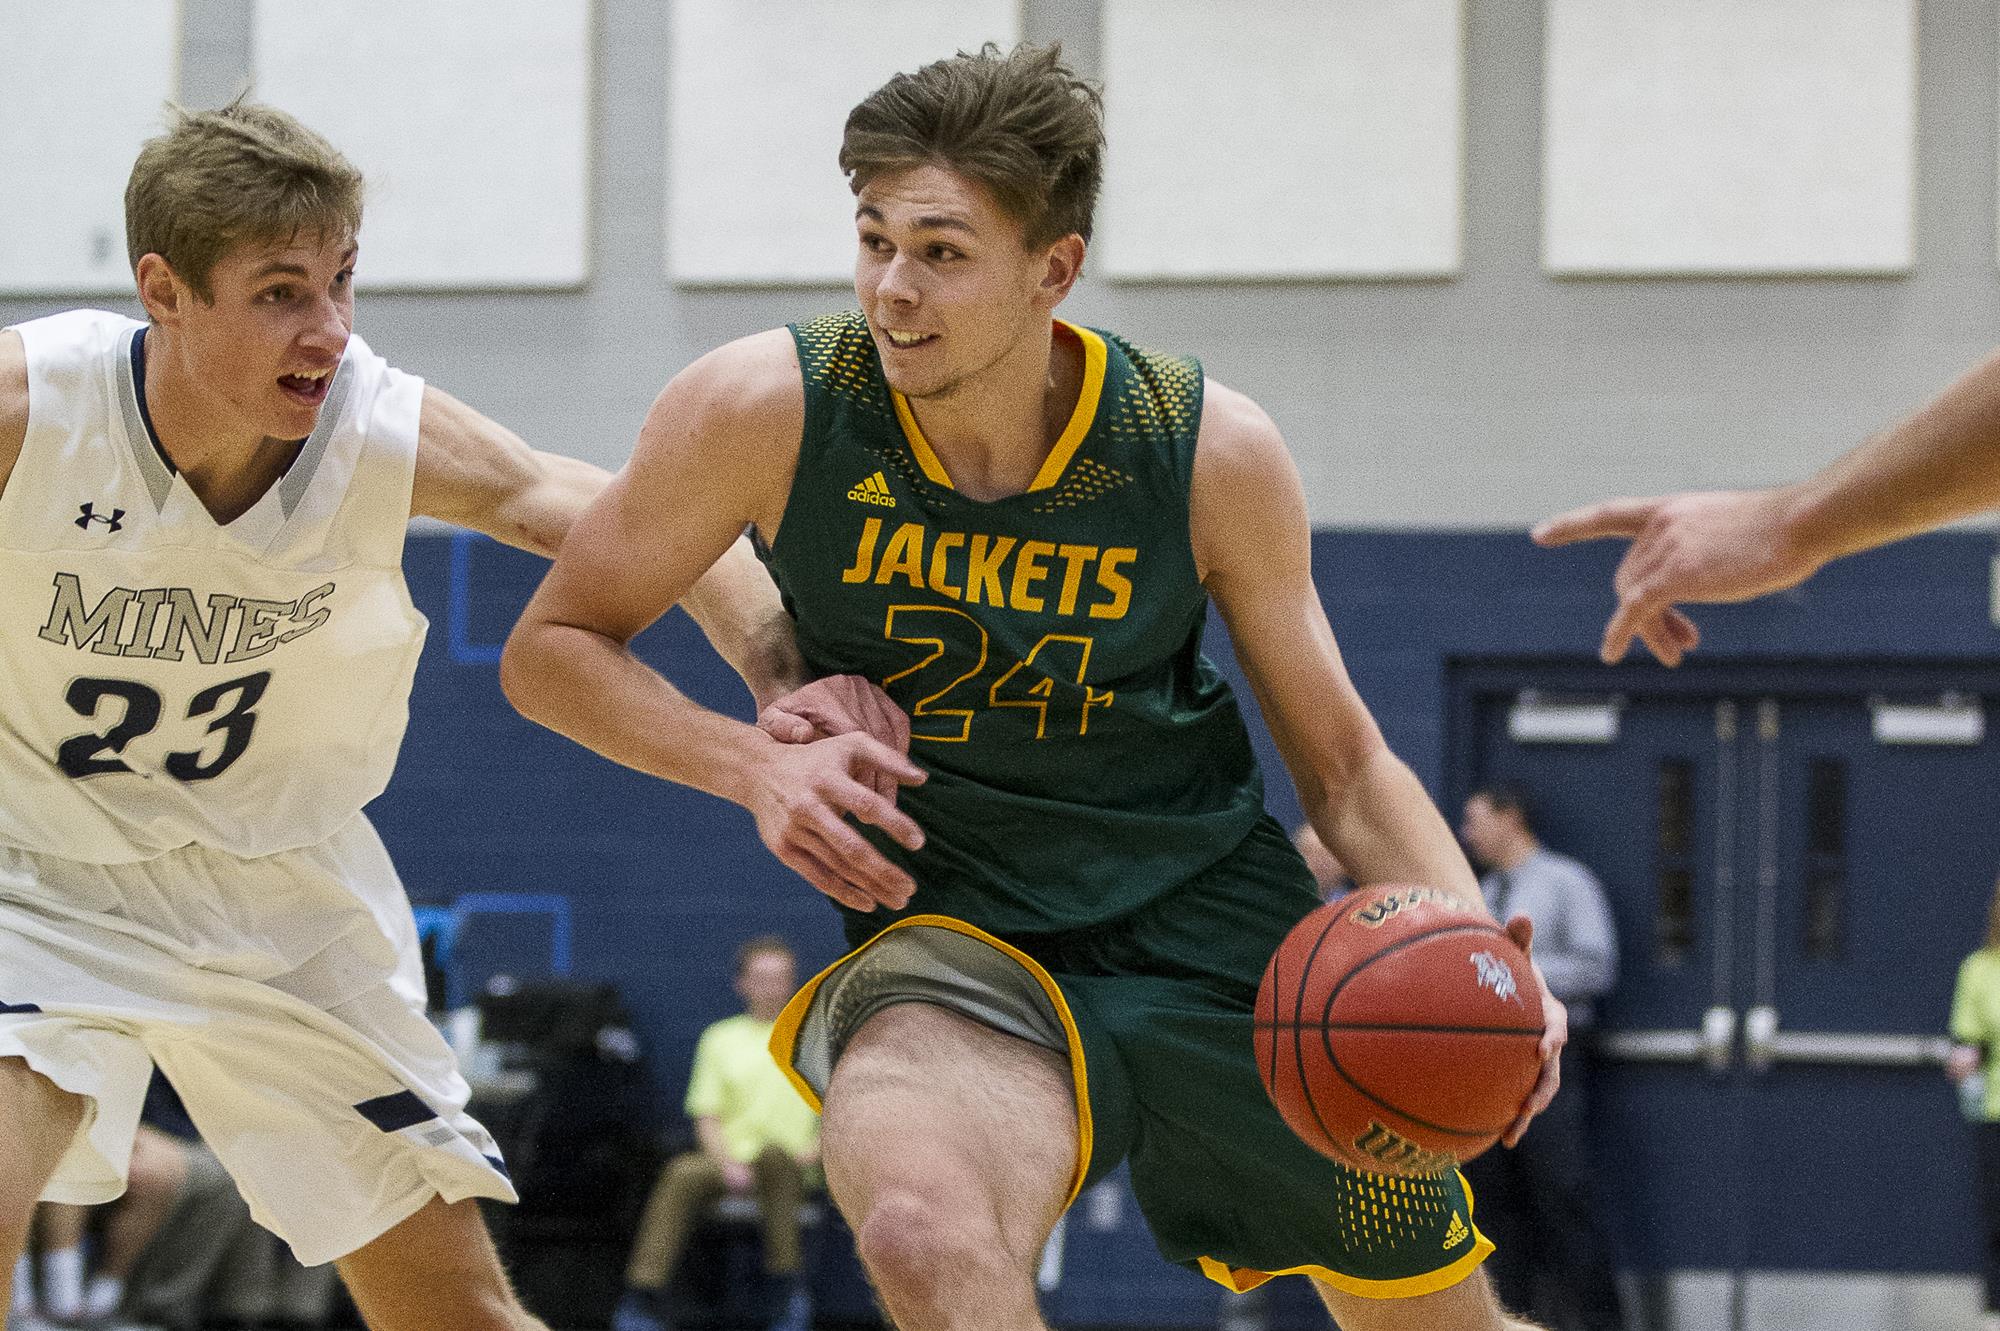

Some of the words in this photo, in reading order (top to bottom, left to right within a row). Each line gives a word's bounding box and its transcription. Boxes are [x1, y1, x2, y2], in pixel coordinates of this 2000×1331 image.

[847, 489, 896, 508] adidas
[37, 571, 336, 664] MINES
[841, 517, 1138, 620] JACKETS
[882, 604, 1114, 742] 24
[56, 670, 272, 782] 23
